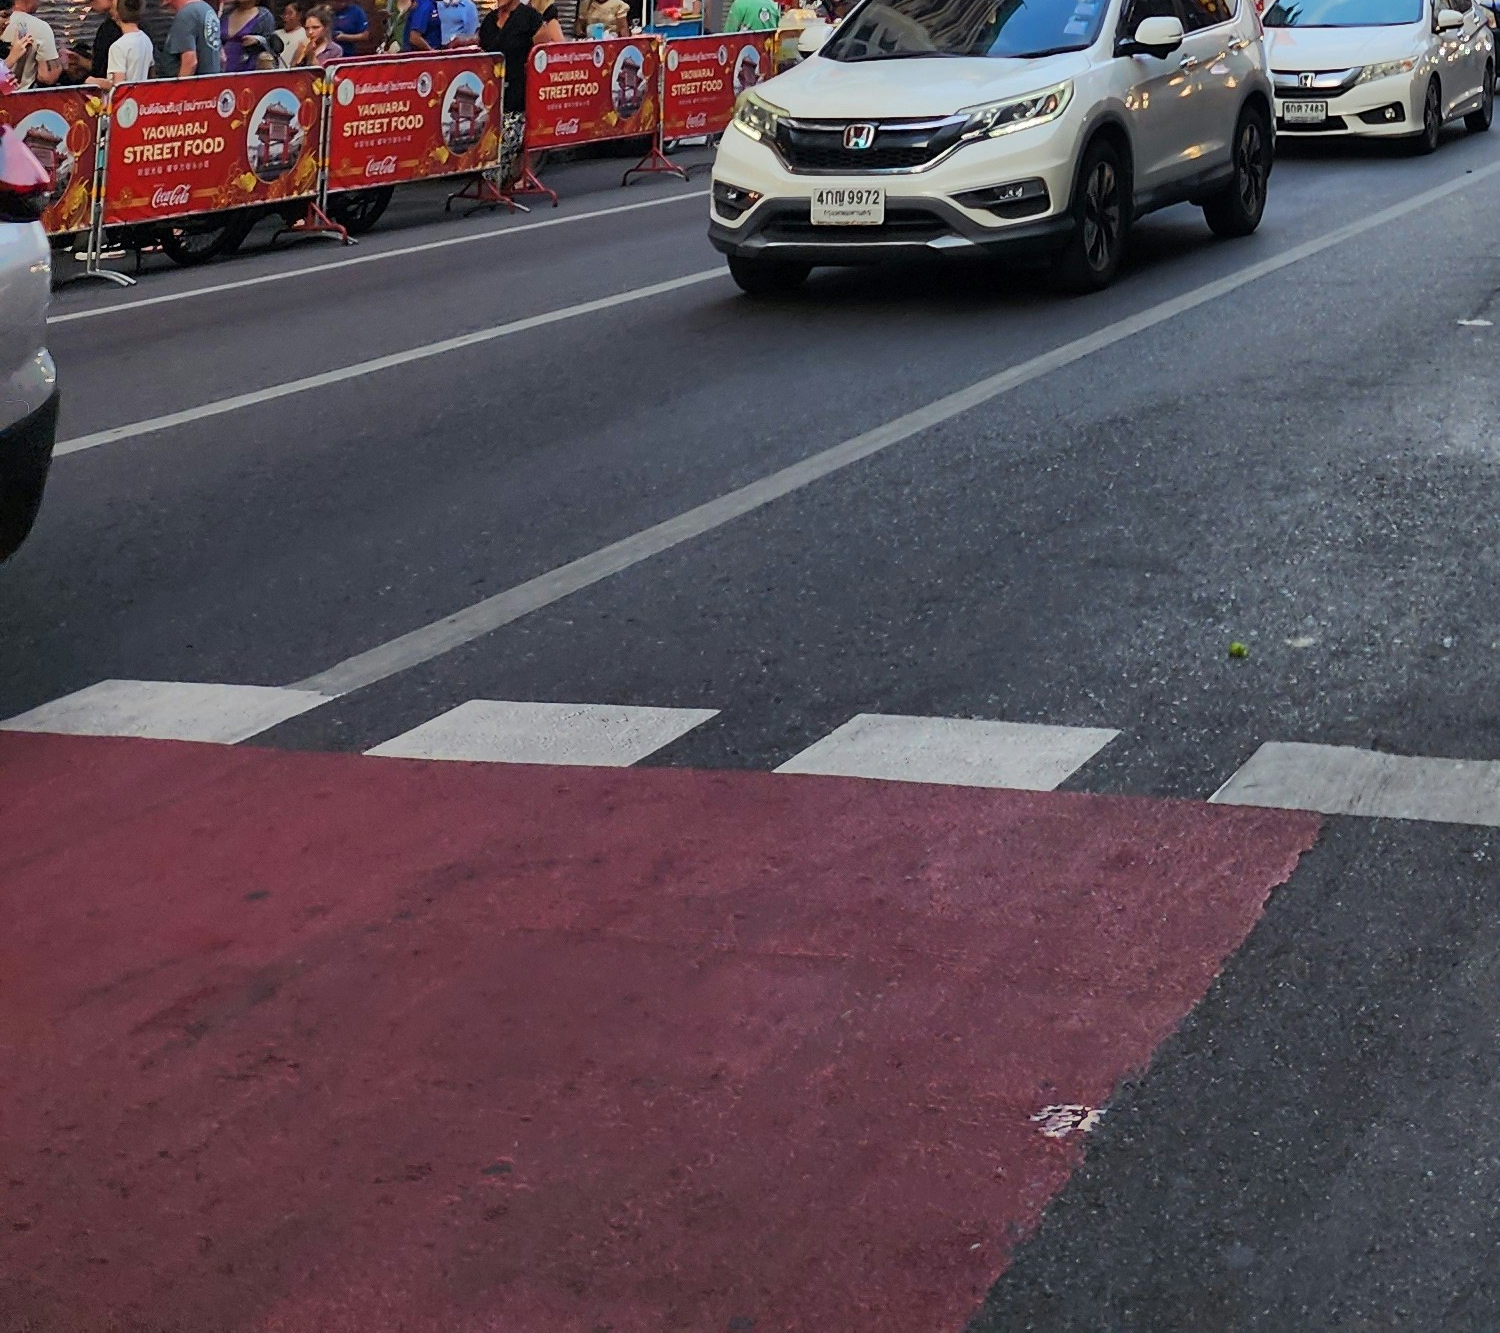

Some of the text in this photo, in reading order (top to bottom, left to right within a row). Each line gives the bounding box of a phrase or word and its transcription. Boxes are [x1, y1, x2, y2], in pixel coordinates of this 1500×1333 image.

[538, 82, 599, 101] STREET FOOD
[671, 79, 723, 97] STREET FOOD
[357, 100, 411, 117] YAOWARAJ
[141, 120, 208, 141] YAOWARAJ
[342, 114, 424, 138] STREET FOOD
[123, 136, 225, 164] STREET FOOD
[848, 189, 880, 206] 9972
